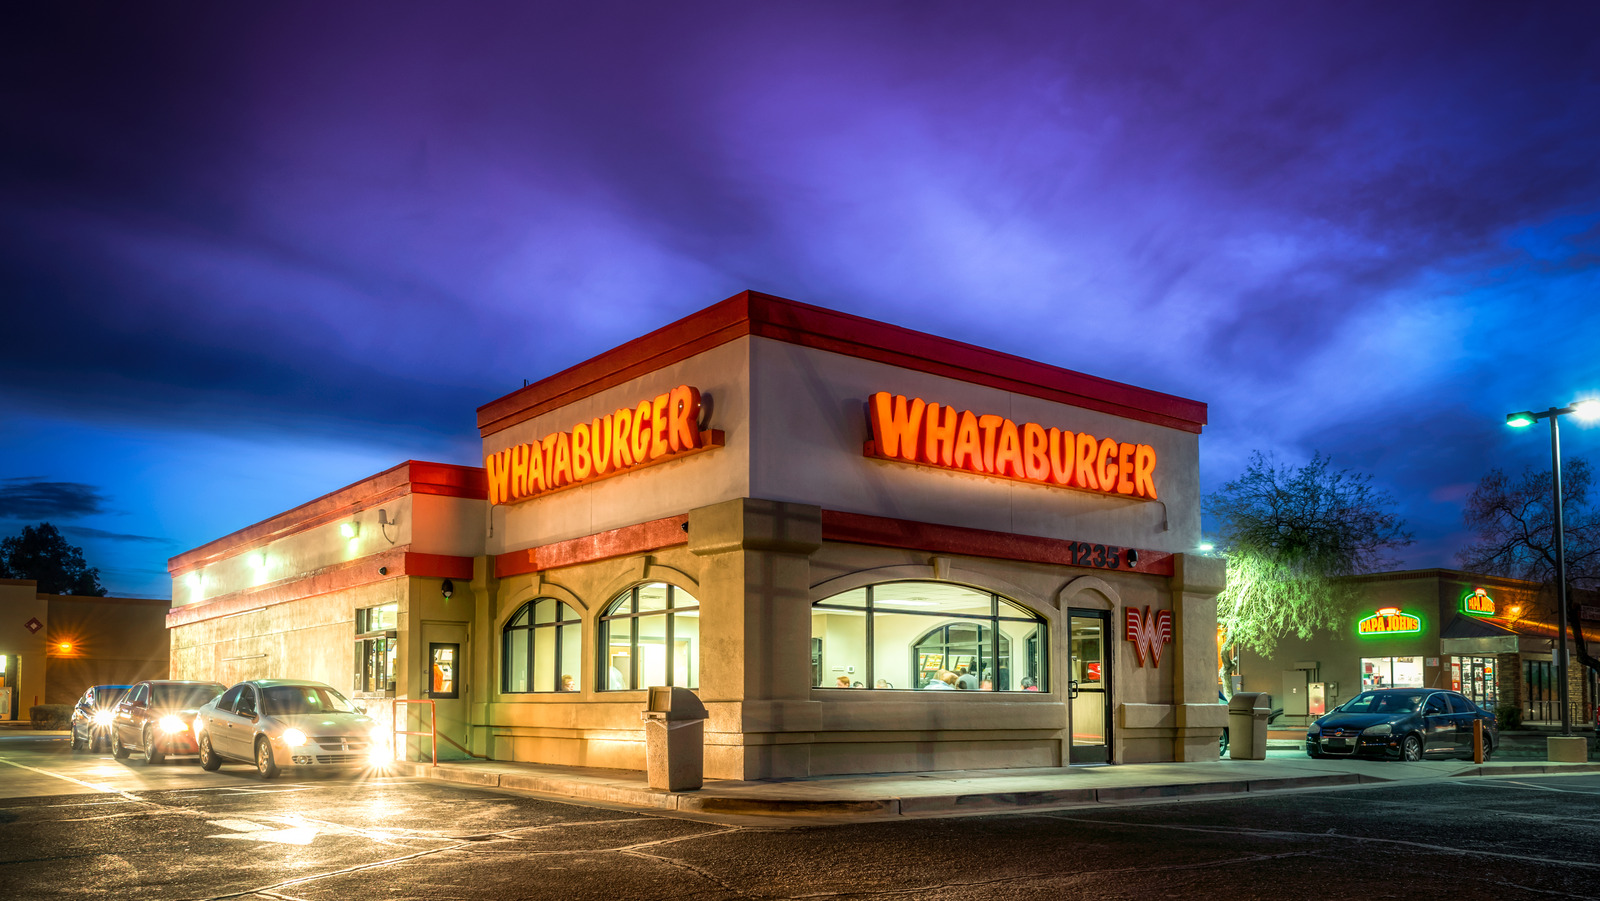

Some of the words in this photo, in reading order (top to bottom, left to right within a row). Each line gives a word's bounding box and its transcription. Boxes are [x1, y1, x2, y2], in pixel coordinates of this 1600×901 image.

[486, 384, 693, 505] WHATABURGER
[875, 391, 1158, 500] WHATABURGER
[1068, 541, 1120, 569] 1235
[1361, 616, 1386, 632] PAPA
